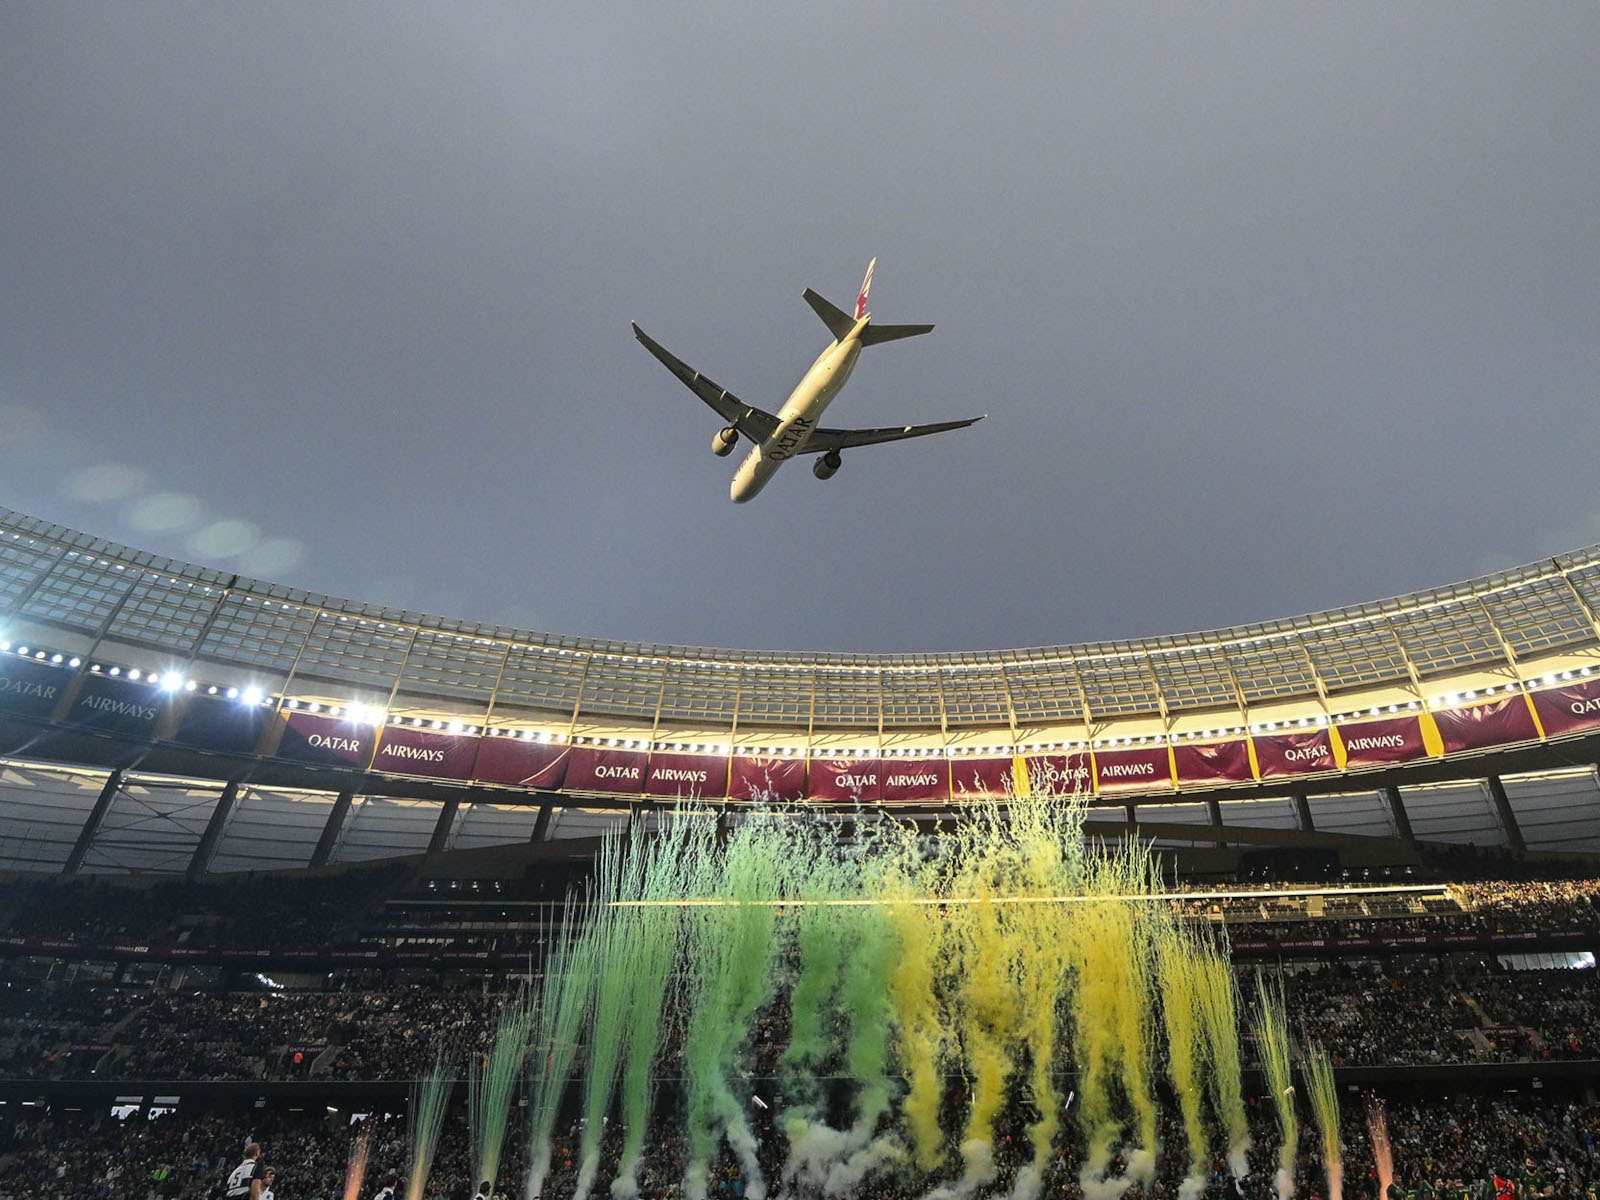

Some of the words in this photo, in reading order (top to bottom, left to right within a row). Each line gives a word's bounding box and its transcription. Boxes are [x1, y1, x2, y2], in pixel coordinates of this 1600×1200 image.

[769, 417, 814, 461] QATAR
[81, 694, 157, 721] AIRWAYS
[308, 734, 360, 753] QATAR
[382, 744, 444, 762] AIRWAYS
[1284, 744, 1329, 762] QATAR
[1347, 734, 1404, 752] AIRWAYS
[595, 765, 640, 780] QATAR
[651, 768, 707, 783] AIRWAYS
[835, 774, 877, 788] QATAR
[885, 774, 938, 787] AIRWAYS
[1049, 768, 1089, 782] QATAR
[1100, 763, 1155, 777] AIRWAYS
